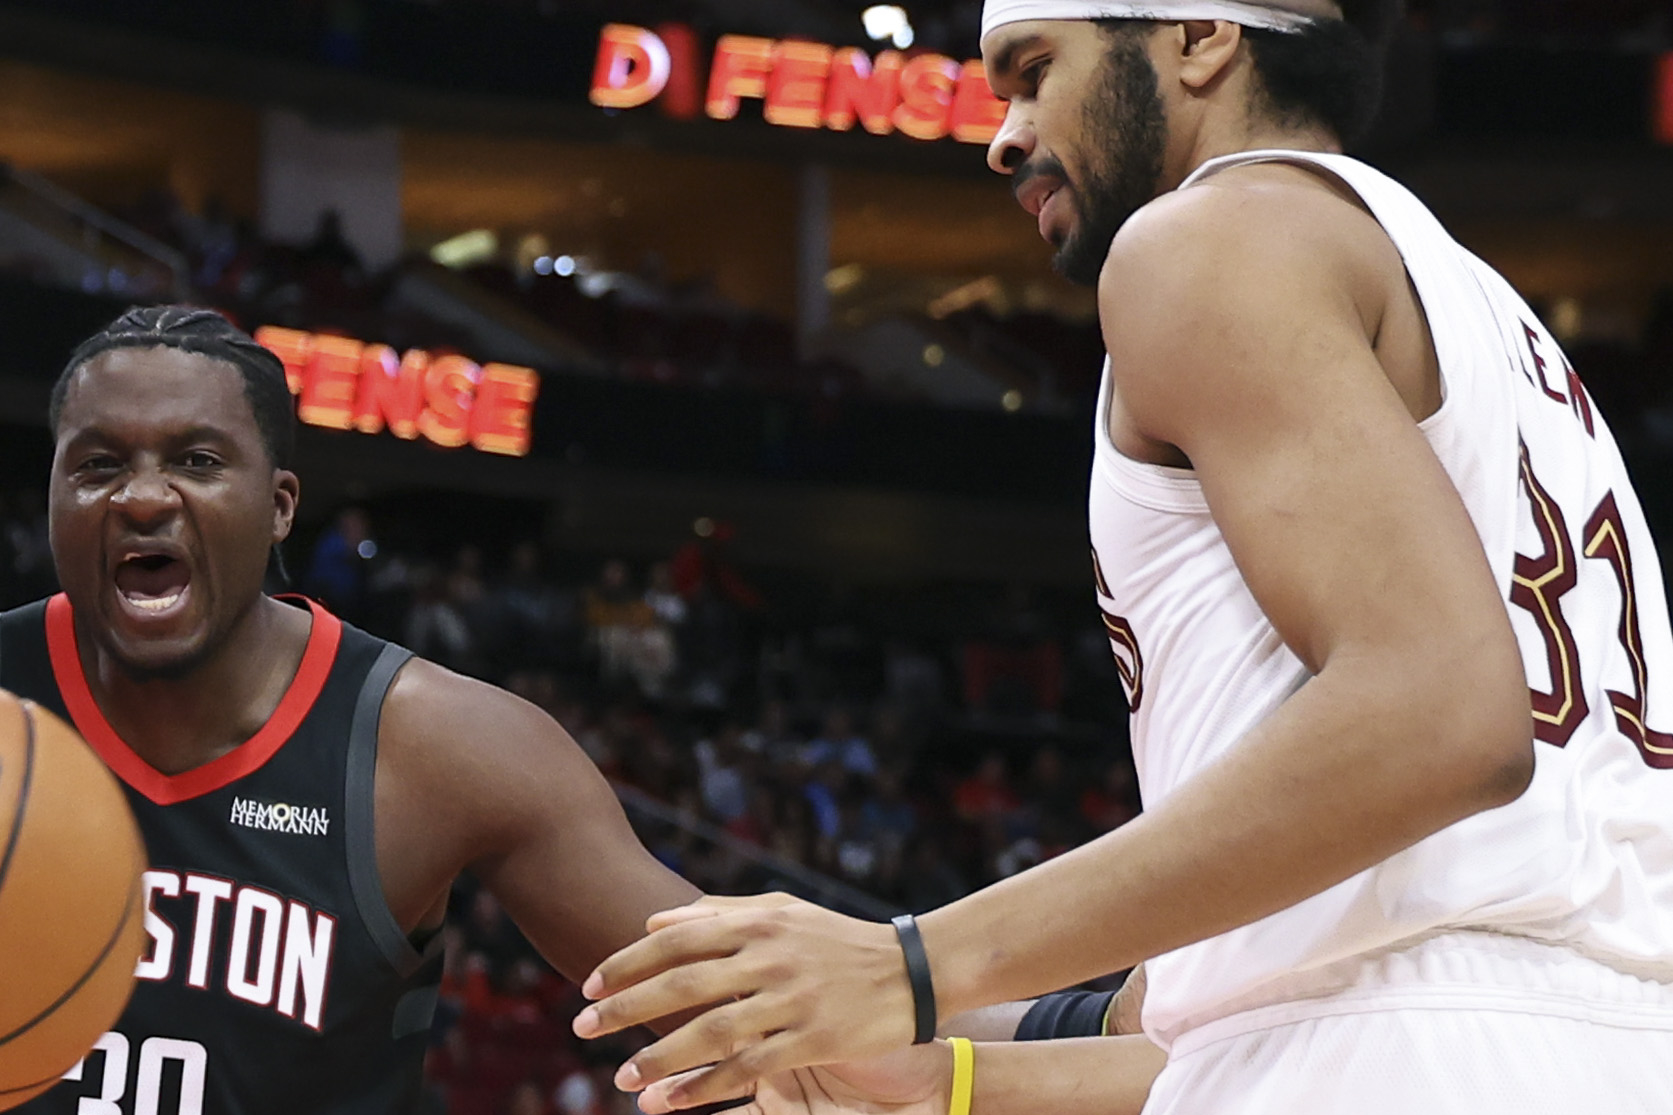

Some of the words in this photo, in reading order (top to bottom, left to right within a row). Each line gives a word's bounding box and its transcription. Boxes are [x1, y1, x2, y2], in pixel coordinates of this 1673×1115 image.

[704, 33, 1012, 145] FENSE
[229, 809, 330, 836] HERMANN
[231, 795, 330, 825] MEMORIAL
[134, 868, 339, 1033] STON
